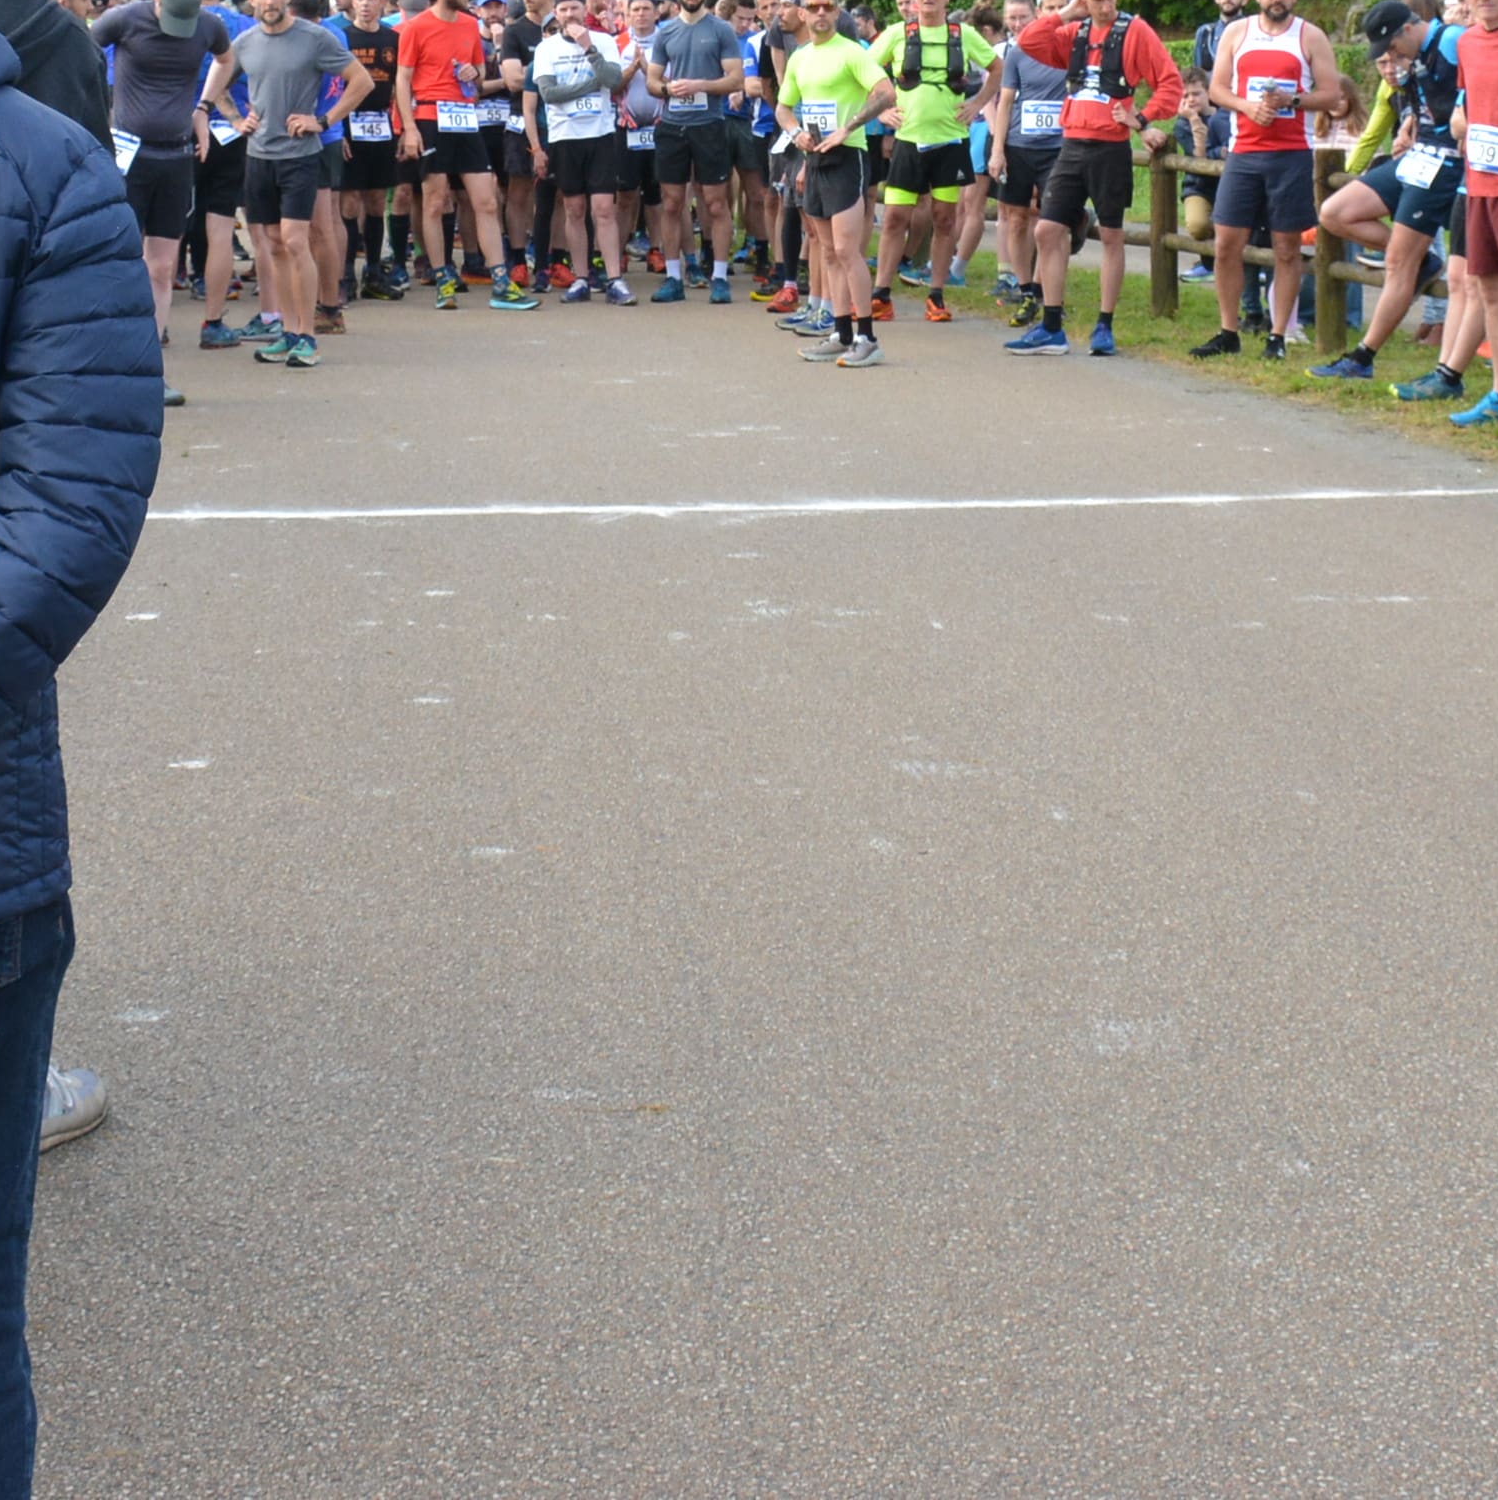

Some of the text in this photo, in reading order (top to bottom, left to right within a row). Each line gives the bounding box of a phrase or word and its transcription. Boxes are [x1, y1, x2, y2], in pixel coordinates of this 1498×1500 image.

[575, 98, 593, 110] 66
[448, 114, 470, 126] 101
[487, 109, 502, 121] 55
[1035, 114, 1054, 128] 80
[360, 123, 383, 136] 145
